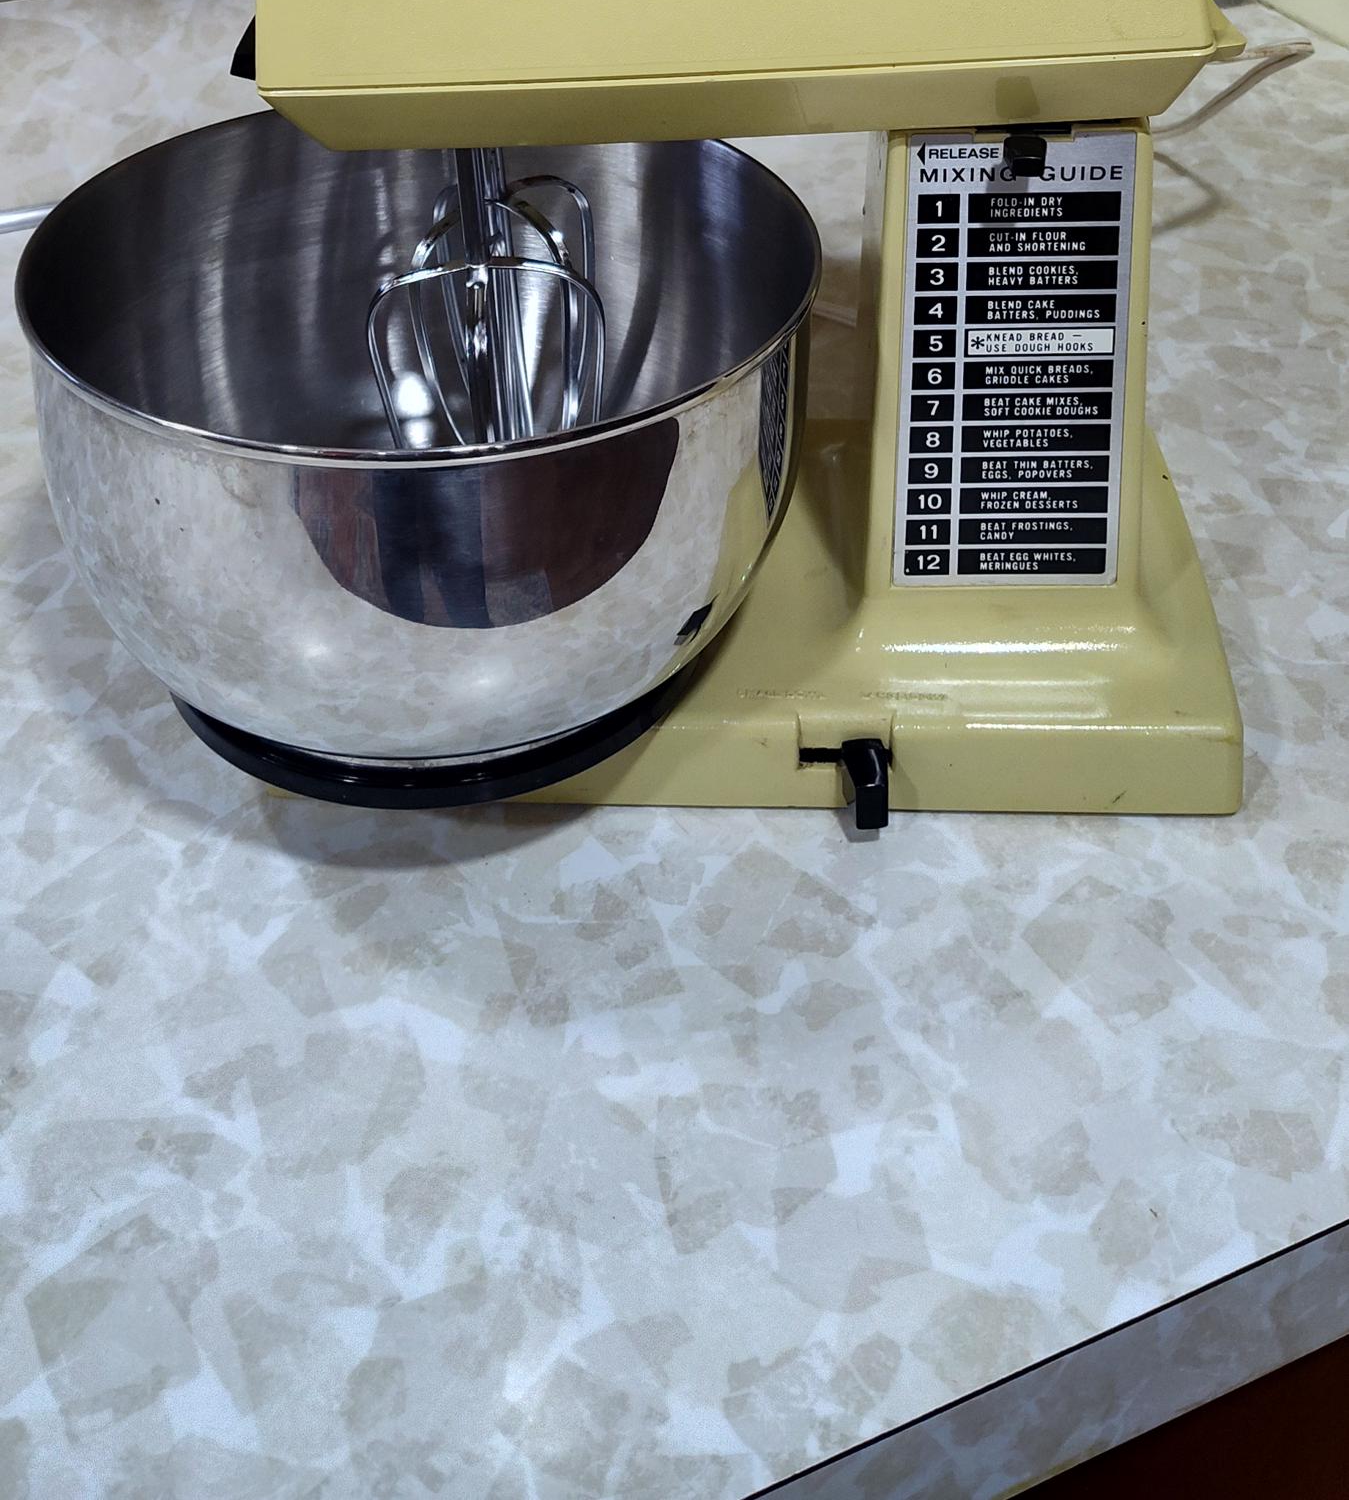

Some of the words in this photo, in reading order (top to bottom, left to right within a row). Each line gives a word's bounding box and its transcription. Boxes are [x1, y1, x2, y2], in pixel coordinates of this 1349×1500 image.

[928, 147, 999, 159] RELEASE
[919, 167, 1017, 183] MIXING
[1039, 165, 1123, 182] GUIDE
[990, 197, 1035, 207] FOLD-IN
[1041, 196, 1063, 206] DRY
[935, 200, 943, 217] 1
[990, 207, 1063, 218] INGREDIENTS
[989, 232, 1026, 242] CUT-IN
[1032, 231, 1067, 241] FLOUR
[931, 234, 946, 252] 2
[989, 243, 1011, 252] AND
[1017, 241, 1086, 252] SHORTENING
[988, 266, 1024, 276] BLEND
[1029, 265, 1079, 275] COOKIES,
[929, 268, 945, 286] 3
[988, 276, 1023, 286] HEAVY
[1029, 276, 1078, 285] BATTERS
[928, 302, 944, 319] 4
[987, 300, 1022, 310] BLEND
[1028, 300, 1055, 309] CAKE
[987, 310, 1039, 320] BATTERS,
[1045, 309, 1100, 319] PUDDINGS
[1029, 332, 1065, 341] BREAD
[929, 335, 943, 352] 5
[986, 343, 1007, 352] USE
[1015, 343, 1050, 352] DOUGH
[1057, 342, 1094, 351] HOOKS
[985, 366, 1005, 375] MIX
[1011, 365, 1042, 374] QUICK
[1048, 364, 1093, 375] BREADS,
[927, 368, 942, 385] 6
[985, 375, 1029, 385] GRIDDLE
[1035, 374, 1069, 384] CAKES
[984, 397, 1010, 407] BEAT
[1015, 397, 1041, 406] CAKE
[1046, 396, 1083, 406] MIXES,
[927, 400, 940, 416] 7
[984, 407, 1010, 416] SOFT
[1014, 406, 1052, 416] COOKIE
[1056, 406, 1098, 415] DOUGHS
[983, 429, 1010, 438] WHIP
[1015, 428, 1073, 438] POTATOES,
[925, 432, 940, 448] 8
[983, 438, 1049, 448] VEGETABLES
[982, 461, 1007, 470] BEAT
[1014, 460, 1037, 469] THIN
[1043, 460, 1093, 470] BATTERS,
[924, 463, 939, 479] 9
[982, 470, 1012, 480] EGGS,
[1018, 469, 1072, 479] POPOVERS
[981, 491, 1007, 500] WHIP
[1013, 491, 1051, 500] CREAM,
[918, 493, 942, 510] 10
[980, 501, 1020, 510] FROZEN
[1025, 500, 1078, 509] DESSERTS
[980, 522, 1006, 531] BEAT
[1011, 521, 1073, 531] FROSTINGS,
[919, 524, 938, 540] 11
[980, 531, 1014, 540] CANDY
[917, 554, 941, 570] 12
[980, 552, 1005, 561] BEAT
[1010, 552, 1029, 561] EGG
[1033, 552, 1076, 562] WHITES,
[980, 562, 1039, 571] MERINGUES
